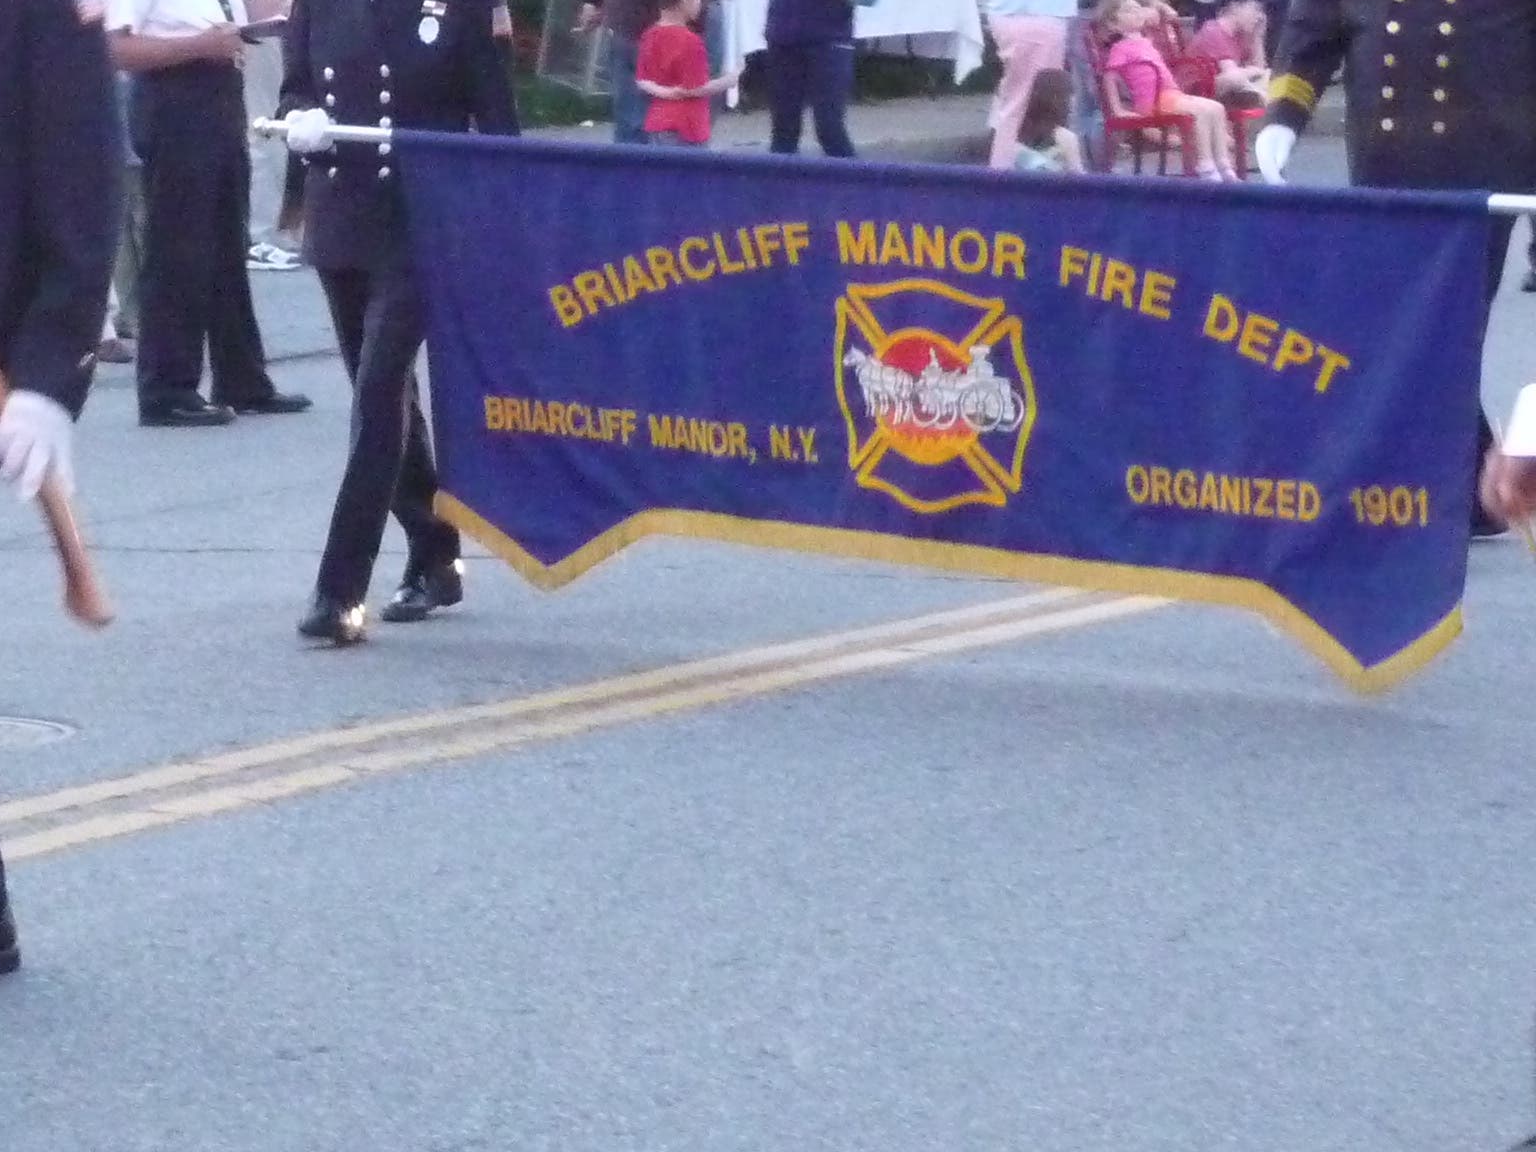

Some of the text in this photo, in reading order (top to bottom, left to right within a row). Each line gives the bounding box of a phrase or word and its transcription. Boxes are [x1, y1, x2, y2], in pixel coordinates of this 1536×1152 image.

[549, 220, 1351, 393] BRIARCLIFF MANOR FIRE DEPT
[484, 396, 819, 465] BRIARCLIFF MANOR, N.Y.
[1126, 464, 1429, 527] ORGANIZED 1901
